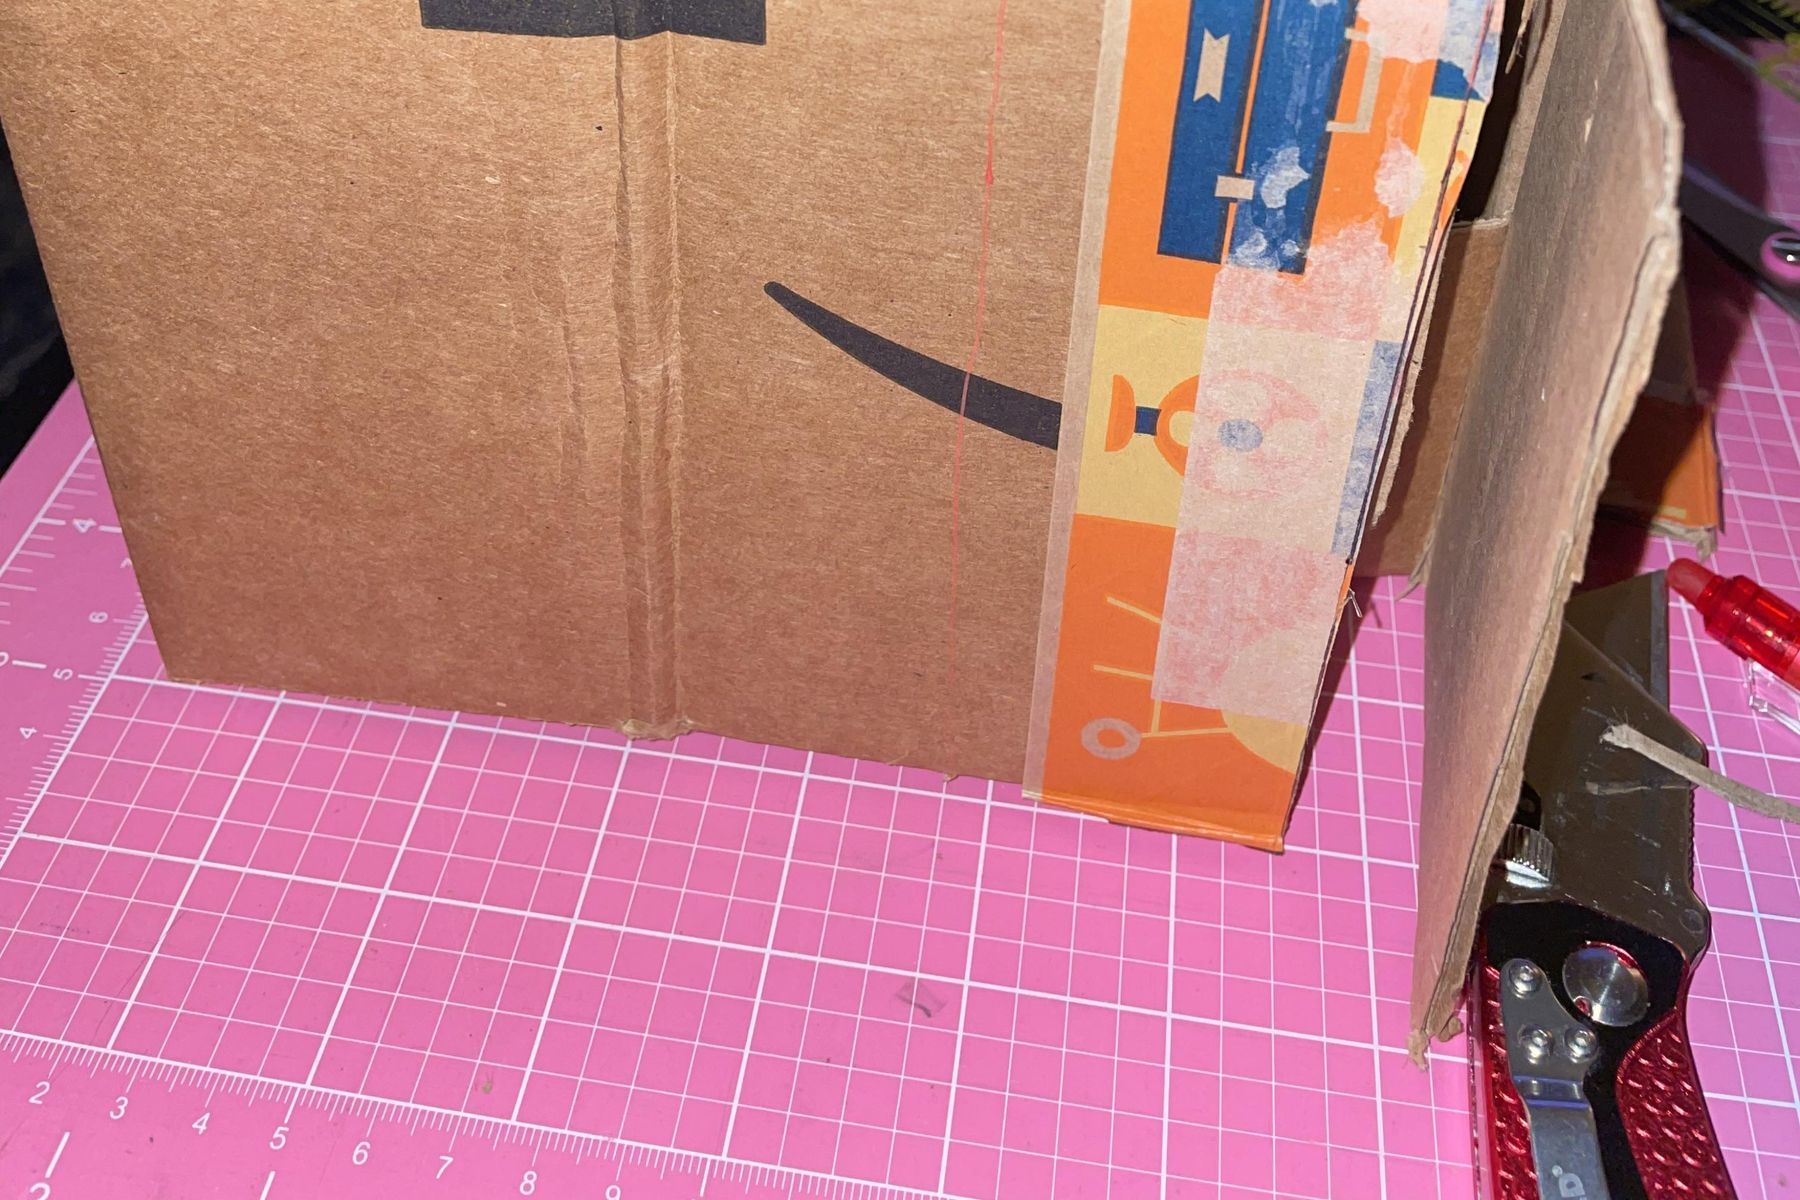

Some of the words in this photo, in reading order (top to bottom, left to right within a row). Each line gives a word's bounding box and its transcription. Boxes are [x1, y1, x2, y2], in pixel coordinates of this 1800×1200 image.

[72, 517, 97, 534] 4
[88, 611, 109, 624] 6
[53, 667, 73, 681] 5
[19, 726, 38, 740] 4
[28, 1081, 50, 1105] 2
[109, 1096, 128, 1120] 3
[191, 1112, 210, 1135] 4
[269, 1126, 289, 1150] 5
[352, 1141, 371, 1165] 6
[435, 1155, 453, 1180] 7
[519, 1170, 537, 1196] 8
